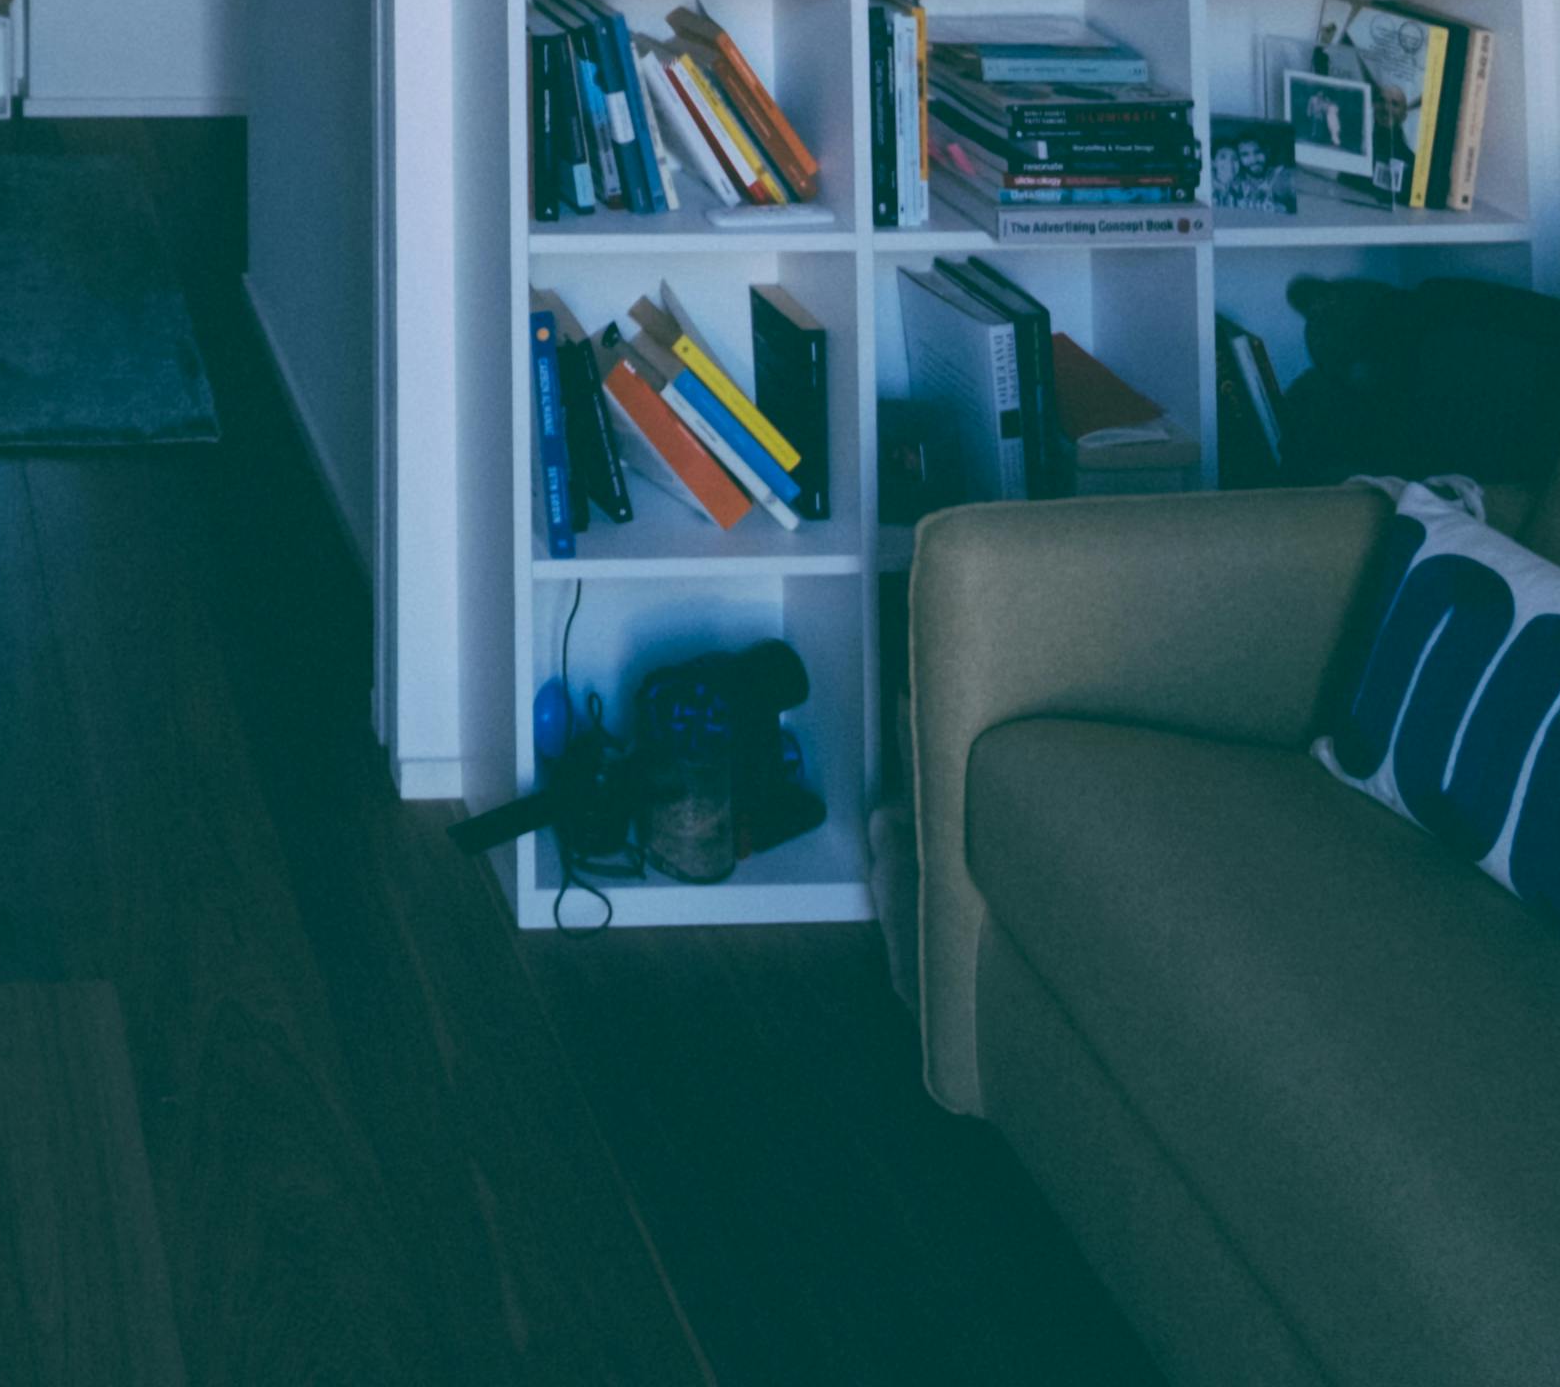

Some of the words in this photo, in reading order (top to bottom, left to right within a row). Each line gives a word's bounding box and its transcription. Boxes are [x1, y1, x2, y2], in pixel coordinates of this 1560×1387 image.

[1023, 162, 1064, 172] resonate
[1010, 221, 1030, 233] The
[1033, 220, 1096, 236] Advertising
[1098, 219, 1144, 236] Concept
[1146, 218, 1173, 232] Book
[537, 356, 549, 393] CARBON
[993, 334, 1009, 406] DAVERIO
[1006, 333, 1020, 401] PHILIPPE
[540, 394, 554, 436] ALMANAC
[546, 466, 558, 491] SETH
[549, 493, 563, 524] GODIN
